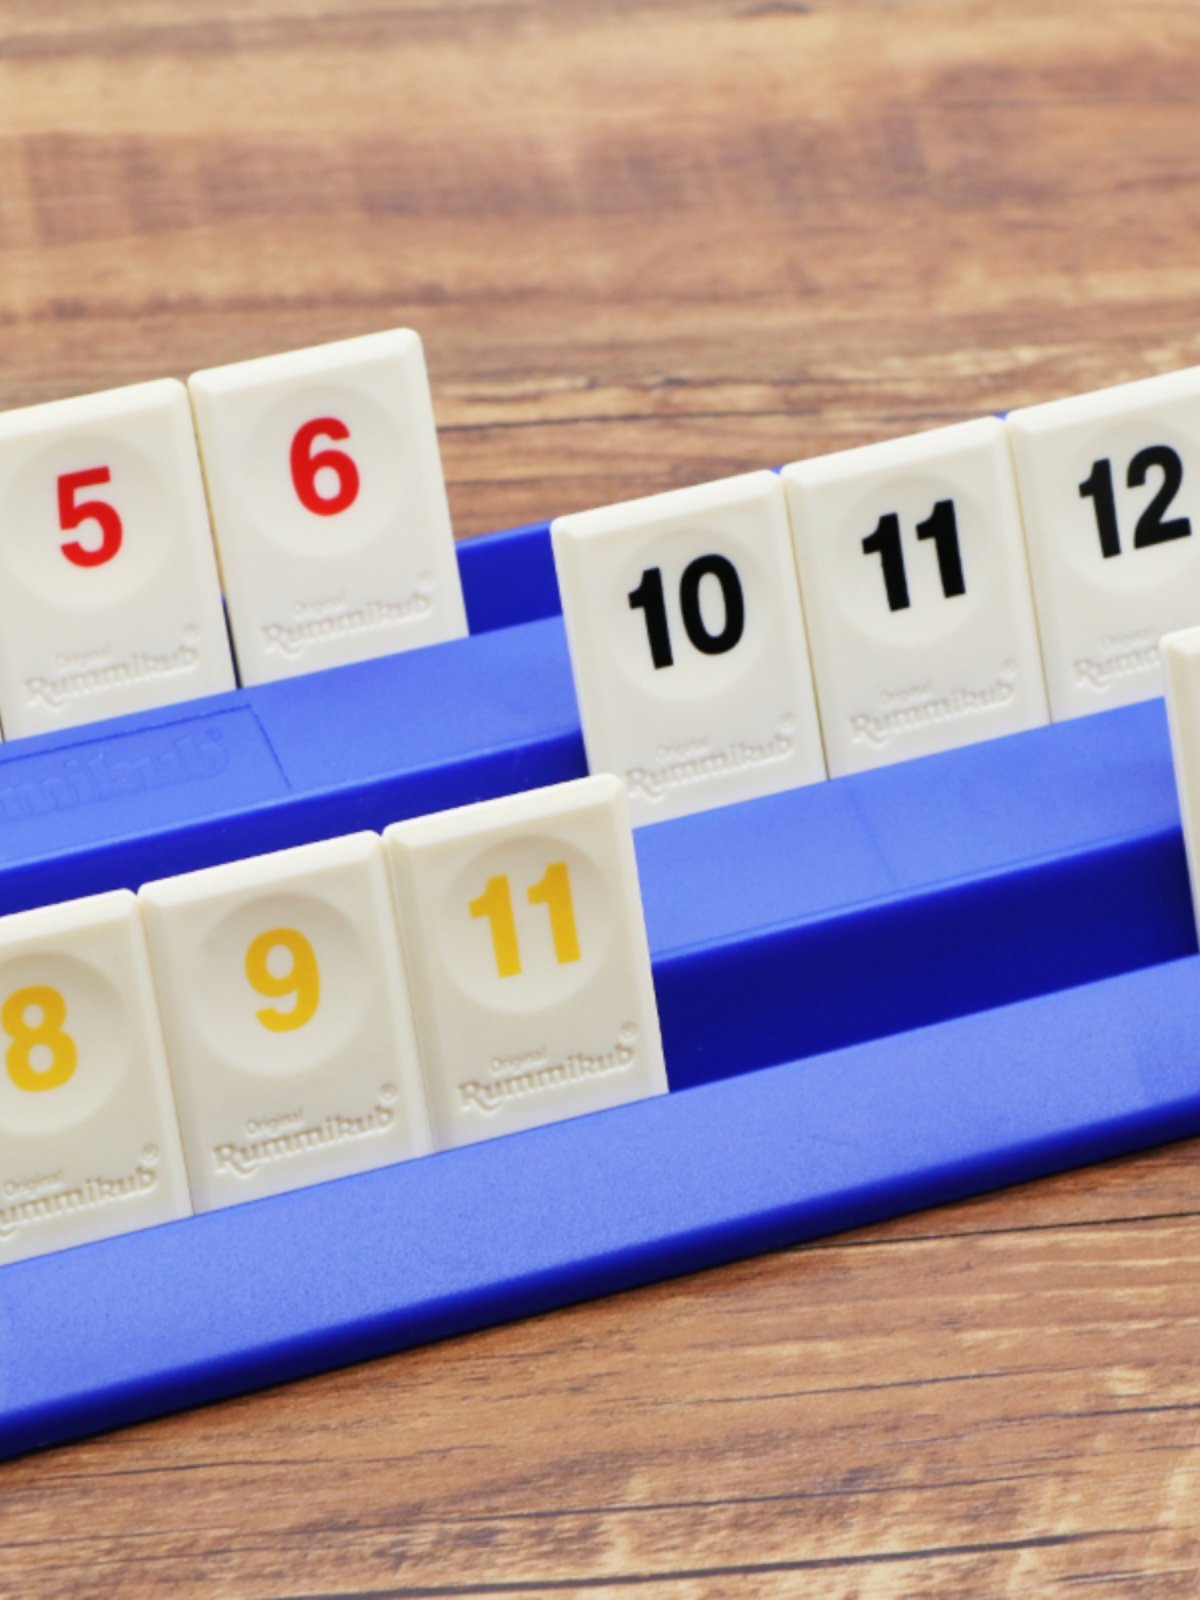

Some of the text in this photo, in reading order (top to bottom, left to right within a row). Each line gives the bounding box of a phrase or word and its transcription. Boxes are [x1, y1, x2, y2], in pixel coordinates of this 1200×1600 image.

[57, 466, 124, 567] 5
[289, 417, 360, 517] 6
[1078, 445, 1192, 559] 12
[861, 499, 966, 612] 11
[627, 553, 745, 670] 10
[468, 861, 581, 978] 11
[244, 927, 321, 1033] 9
[1, 985, 78, 1092] 8
[458, 1043, 634, 1116] Rummikub
[213, 1104, 395, 1179] Rummikub
[0, 1166, 158, 1242] ummikub
